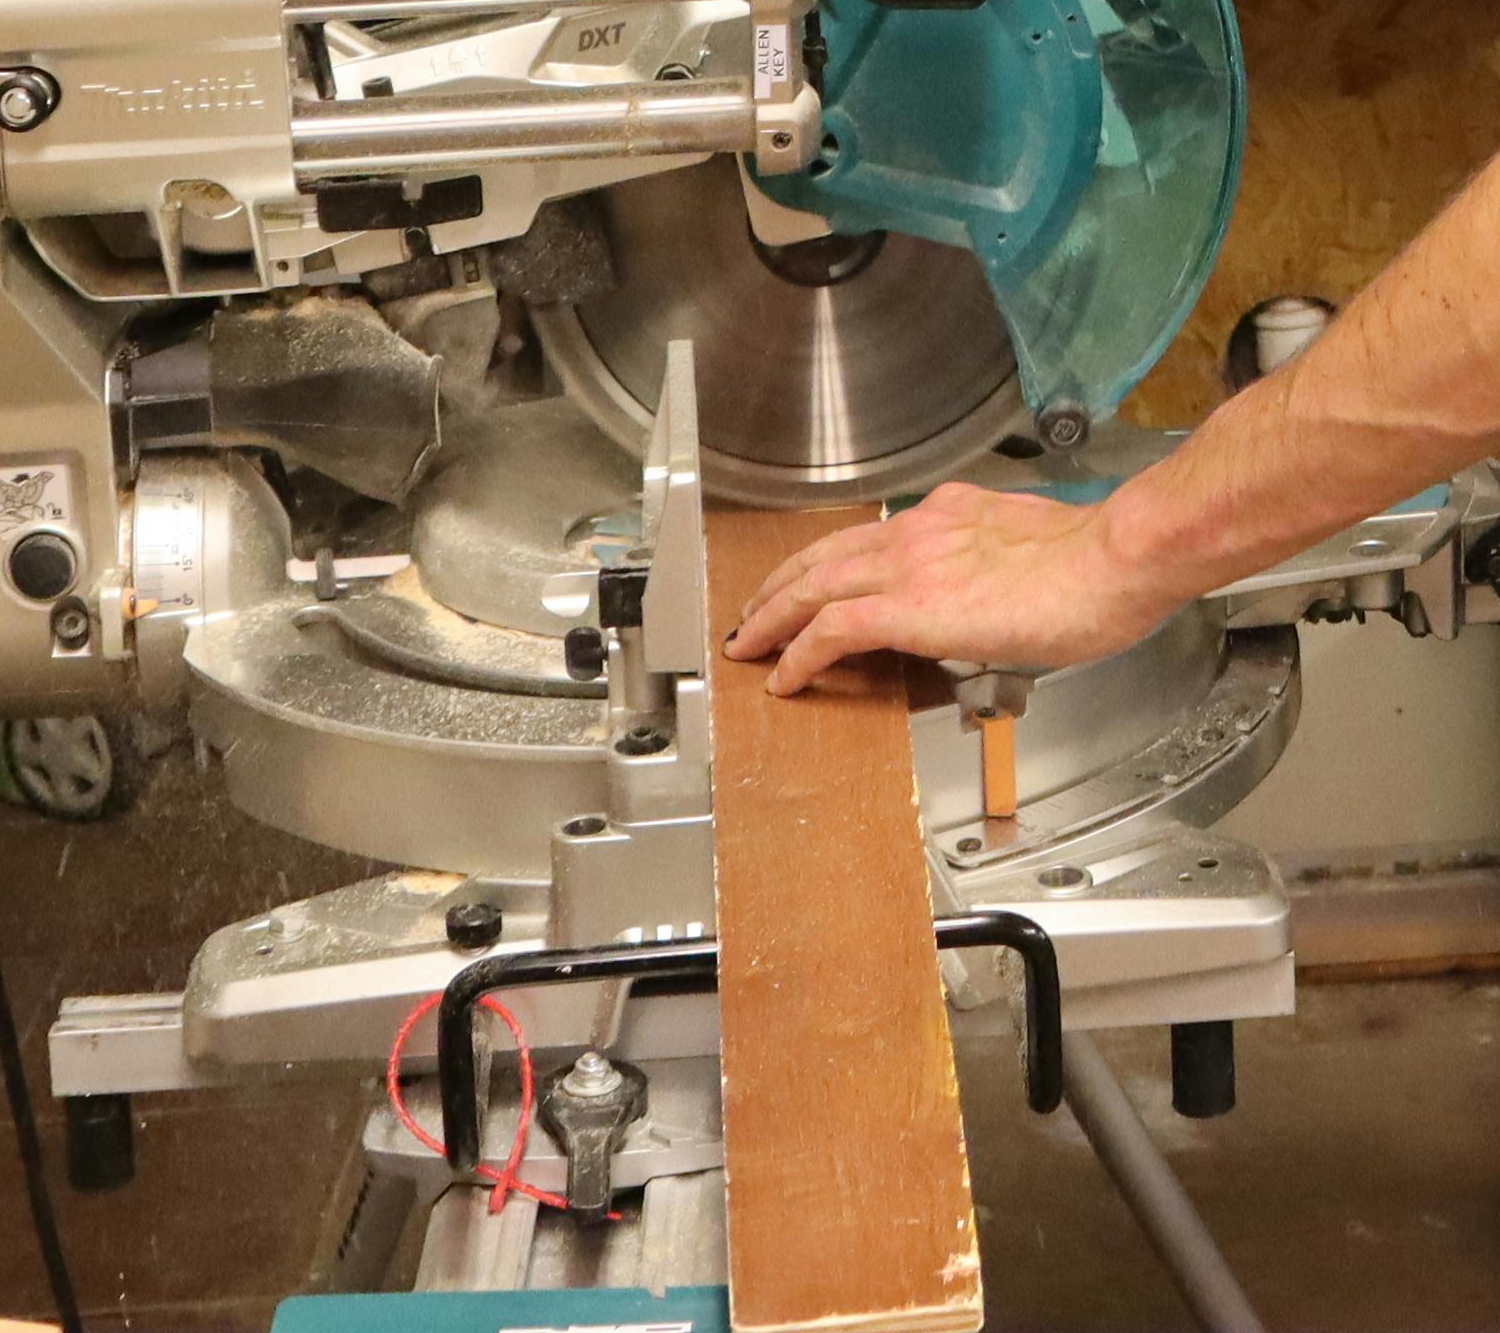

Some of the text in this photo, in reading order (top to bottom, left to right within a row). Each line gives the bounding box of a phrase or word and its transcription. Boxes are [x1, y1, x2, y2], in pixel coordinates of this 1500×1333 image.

[578, 23, 626, 52] DXT
[758, 29, 770, 75] ALLEN
[773, 48, 785, 77] KEY
